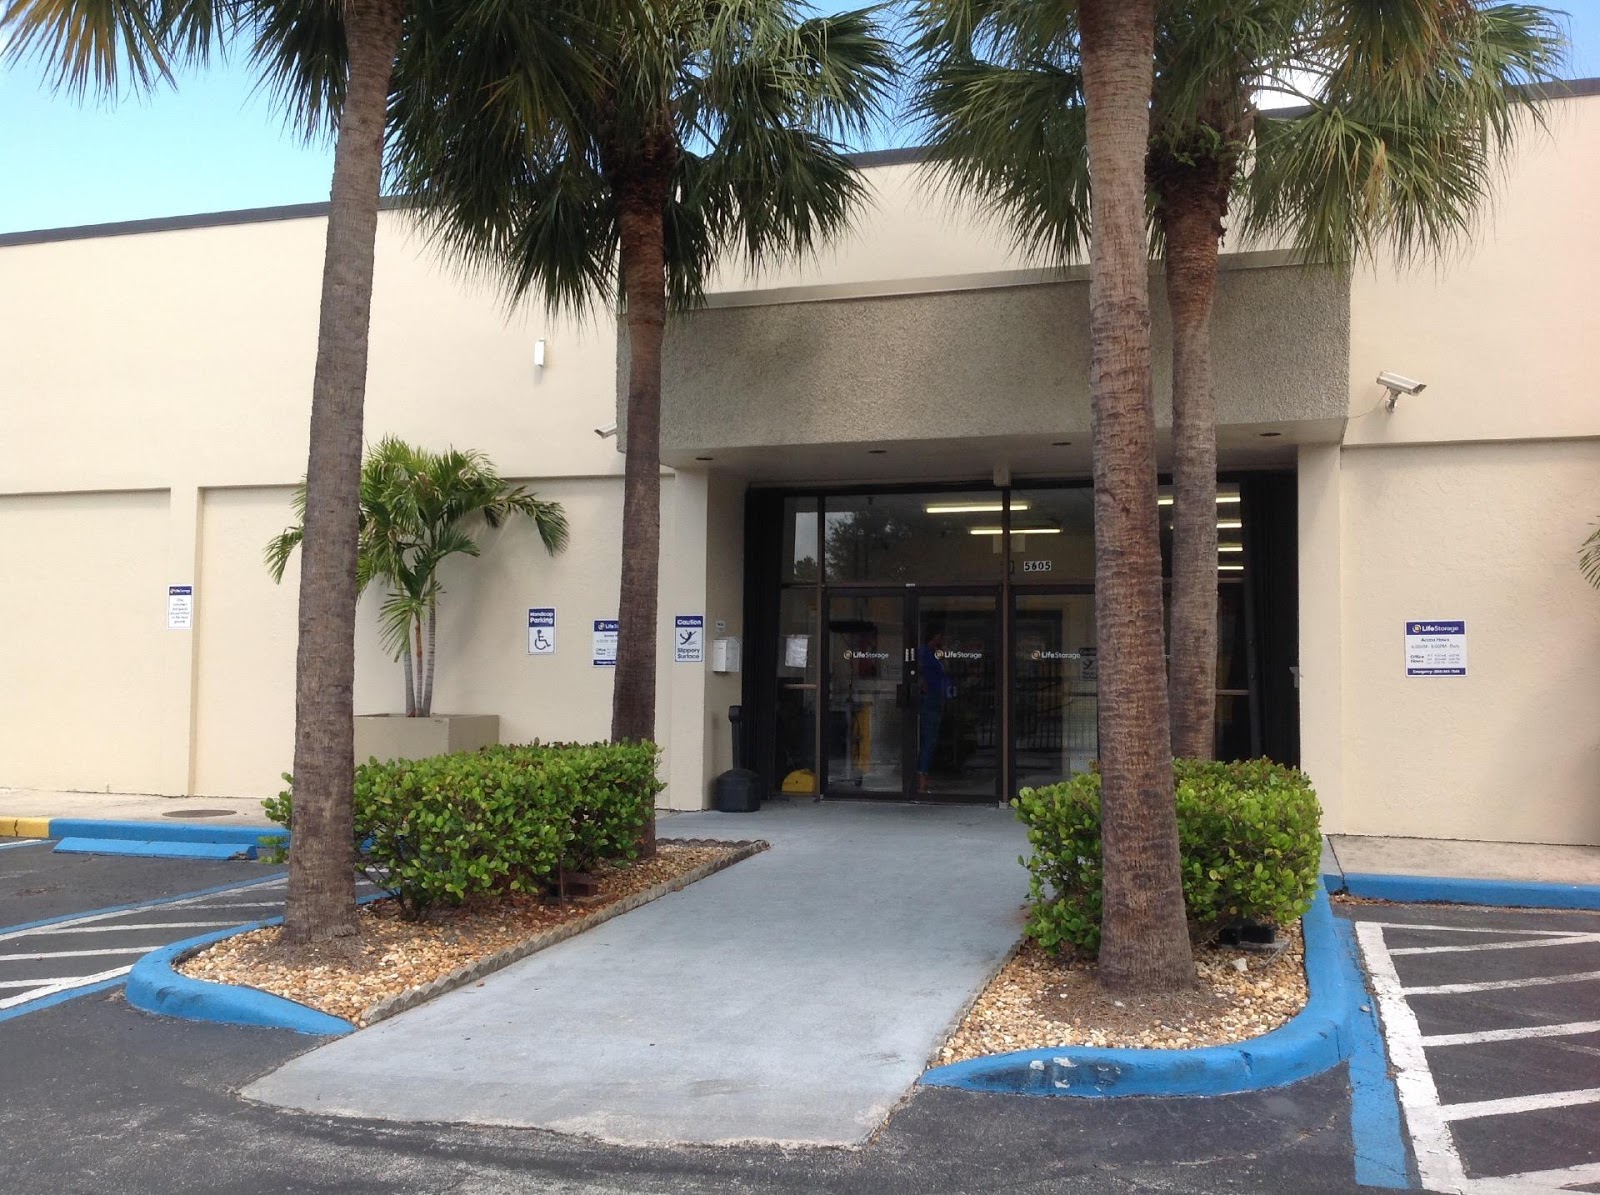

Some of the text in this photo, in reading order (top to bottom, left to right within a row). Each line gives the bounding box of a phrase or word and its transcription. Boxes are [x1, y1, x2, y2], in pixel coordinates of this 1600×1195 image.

[1024, 561, 1051, 571] 5605
[1422, 625, 1459, 633] LifeStorage
[853, 651, 889, 660] LifeStorage
[945, 651, 982, 660] LifeStorage
[1041, 651, 1081, 660] LifeStorage
